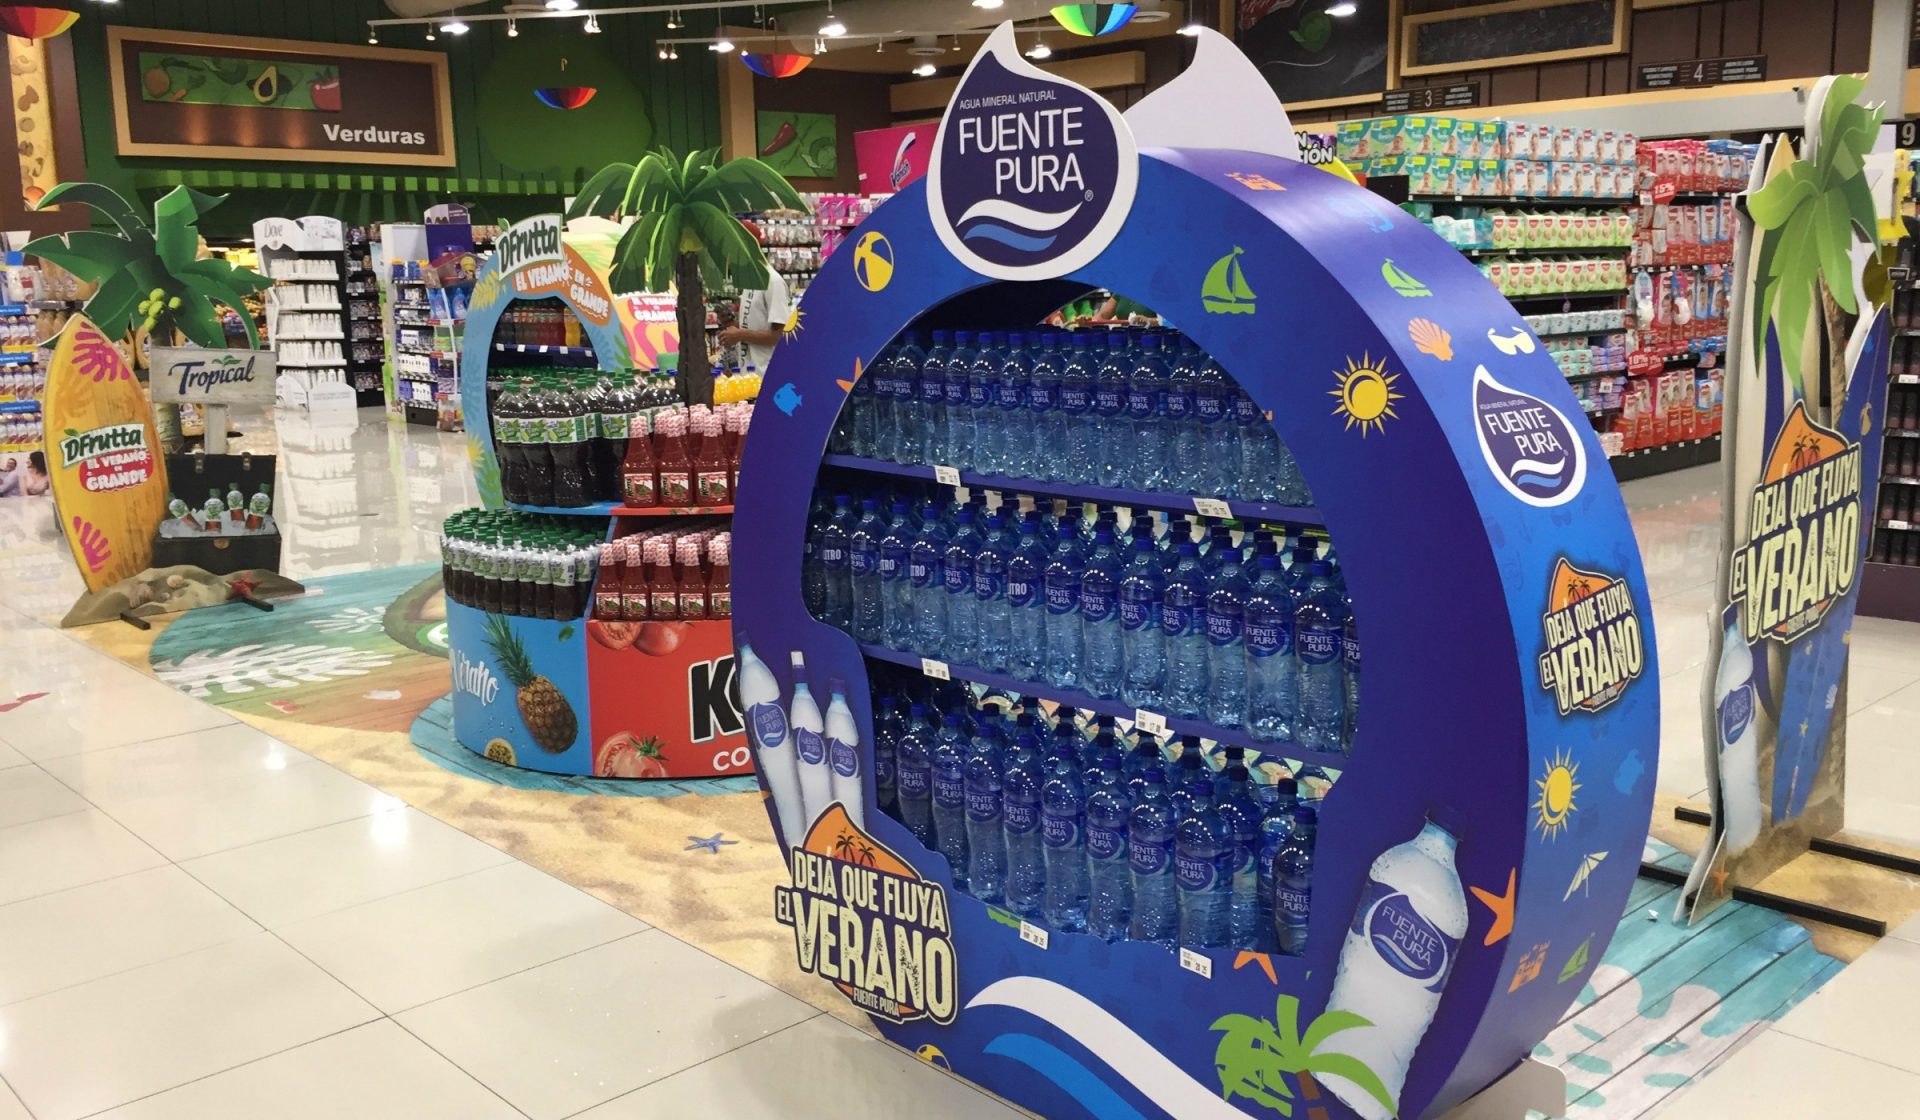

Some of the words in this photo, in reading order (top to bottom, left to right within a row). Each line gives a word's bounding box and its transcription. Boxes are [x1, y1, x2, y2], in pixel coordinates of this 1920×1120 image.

[1693, 63, 1703, 82] 4
[960, 98, 981, 110] AGUA
[982, 94, 1017, 107] MINERAL
[1019, 89, 1057, 104] NATURAL
[1424, 89, 1433, 107] 3
[322, 124, 426, 145] Verduras
[959, 106, 1084, 155] FUENTE
[1902, 122, 1916, 146] 9
[995, 152, 1085, 195] PURA
[168, 355, 256, 395] Tropical
[1484, 407, 1551, 436] FUENTE
[64, 427, 141, 462] DFrutta
[1514, 430, 1563, 457] PURA
[86, 468, 148, 490] GRANDE
[1790, 466, 1820, 527] QUE
[1820, 450, 1859, 509] FLUYA
[1734, 553, 1747, 594] EL
[1747, 501, 1859, 638] VERANO
[1575, 597, 1598, 637] QUE
[1596, 583, 1631, 624] FLUYA
[1246, 627, 1277, 637] FUENTE
[1254, 636, 1277, 645] PURA
[1300, 635, 1334, 645] FUENTE
[1307, 643, 1334, 652] PURA
[1542, 657, 1555, 684] EL
[1551, 616, 1641, 710] VERANO
[942, 790, 963, 798] PURA
[972, 802, 994, 811] PURA
[841, 866, 879, 911] QUE
[883, 875, 946, 933] FLUYA
[1277, 889, 1309, 903] FUENTE
[1283, 901, 1310, 912] PURA
[1381, 905, 1438, 953] FUENTE
[777, 889, 794, 922] EL
[793, 891, 953, 1018] VERANO
[1392, 928, 1431, 966] PURA
